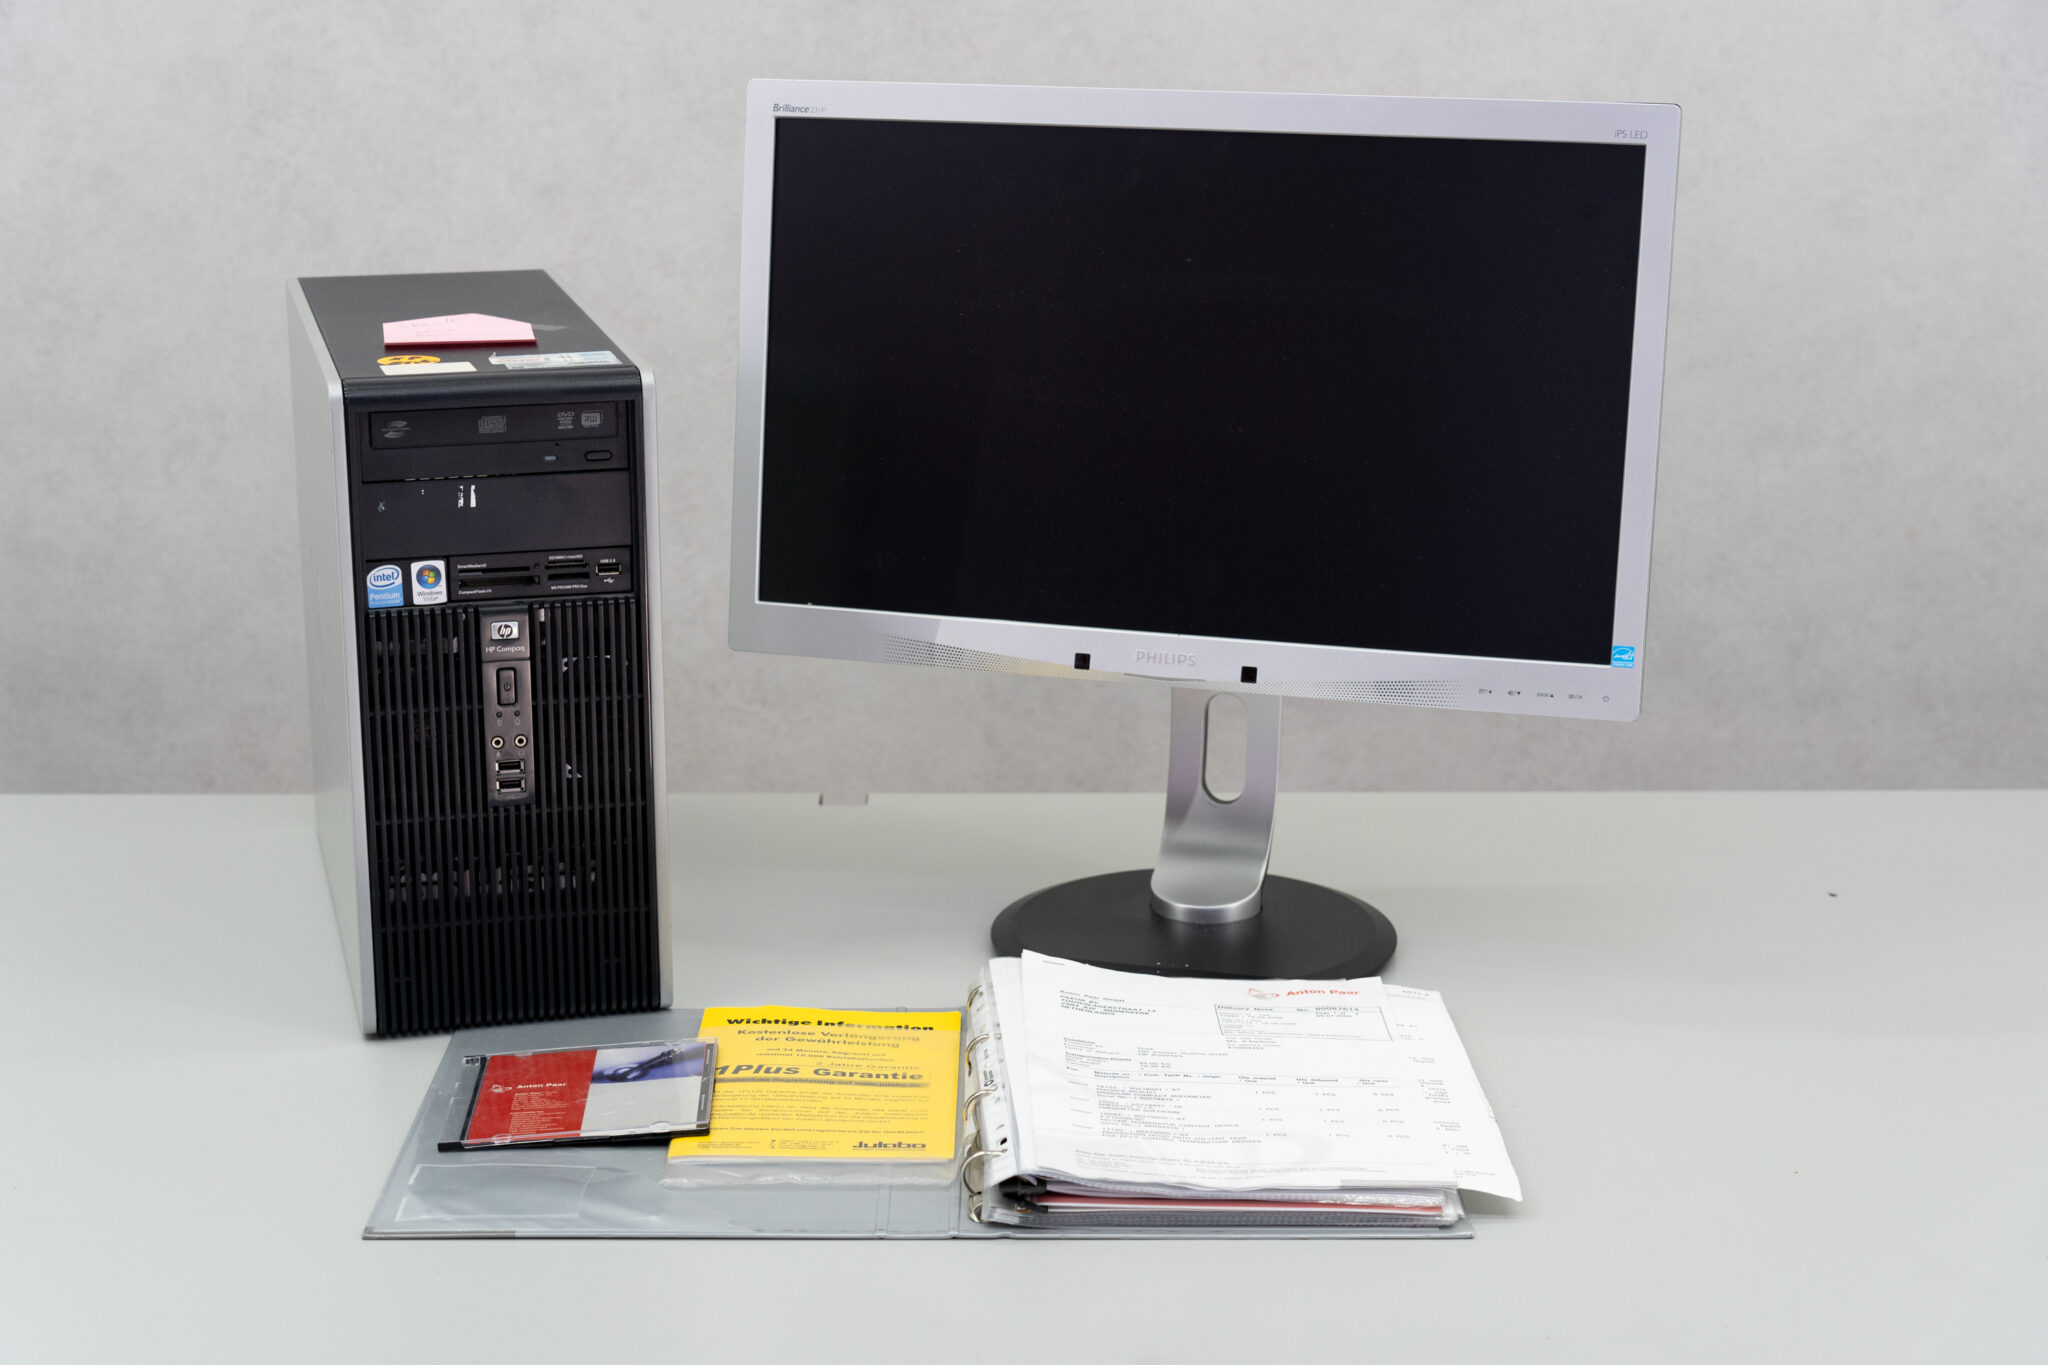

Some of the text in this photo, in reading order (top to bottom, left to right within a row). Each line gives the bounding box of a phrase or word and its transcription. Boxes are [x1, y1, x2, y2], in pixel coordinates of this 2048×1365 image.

[773, 103, 810, 113] Brilliance
[1614, 129, 1648, 140] IPS LED
[372, 572, 396, 583] intel
[369, 592, 401, 601] Pentium
[417, 590, 443, 598] Windows
[485, 644, 526, 654] HP Compaq
[1136, 650, 1197, 666] PHILIPS
[1286, 988, 1326, 996] Anton
[726, 1018, 934, 1031] Wichtige Information
[785, 1036, 900, 1048] Gewährleistung
[820, 1032, 921, 1042] Verlängerung
[813, 1068, 924, 1080] Garantie
